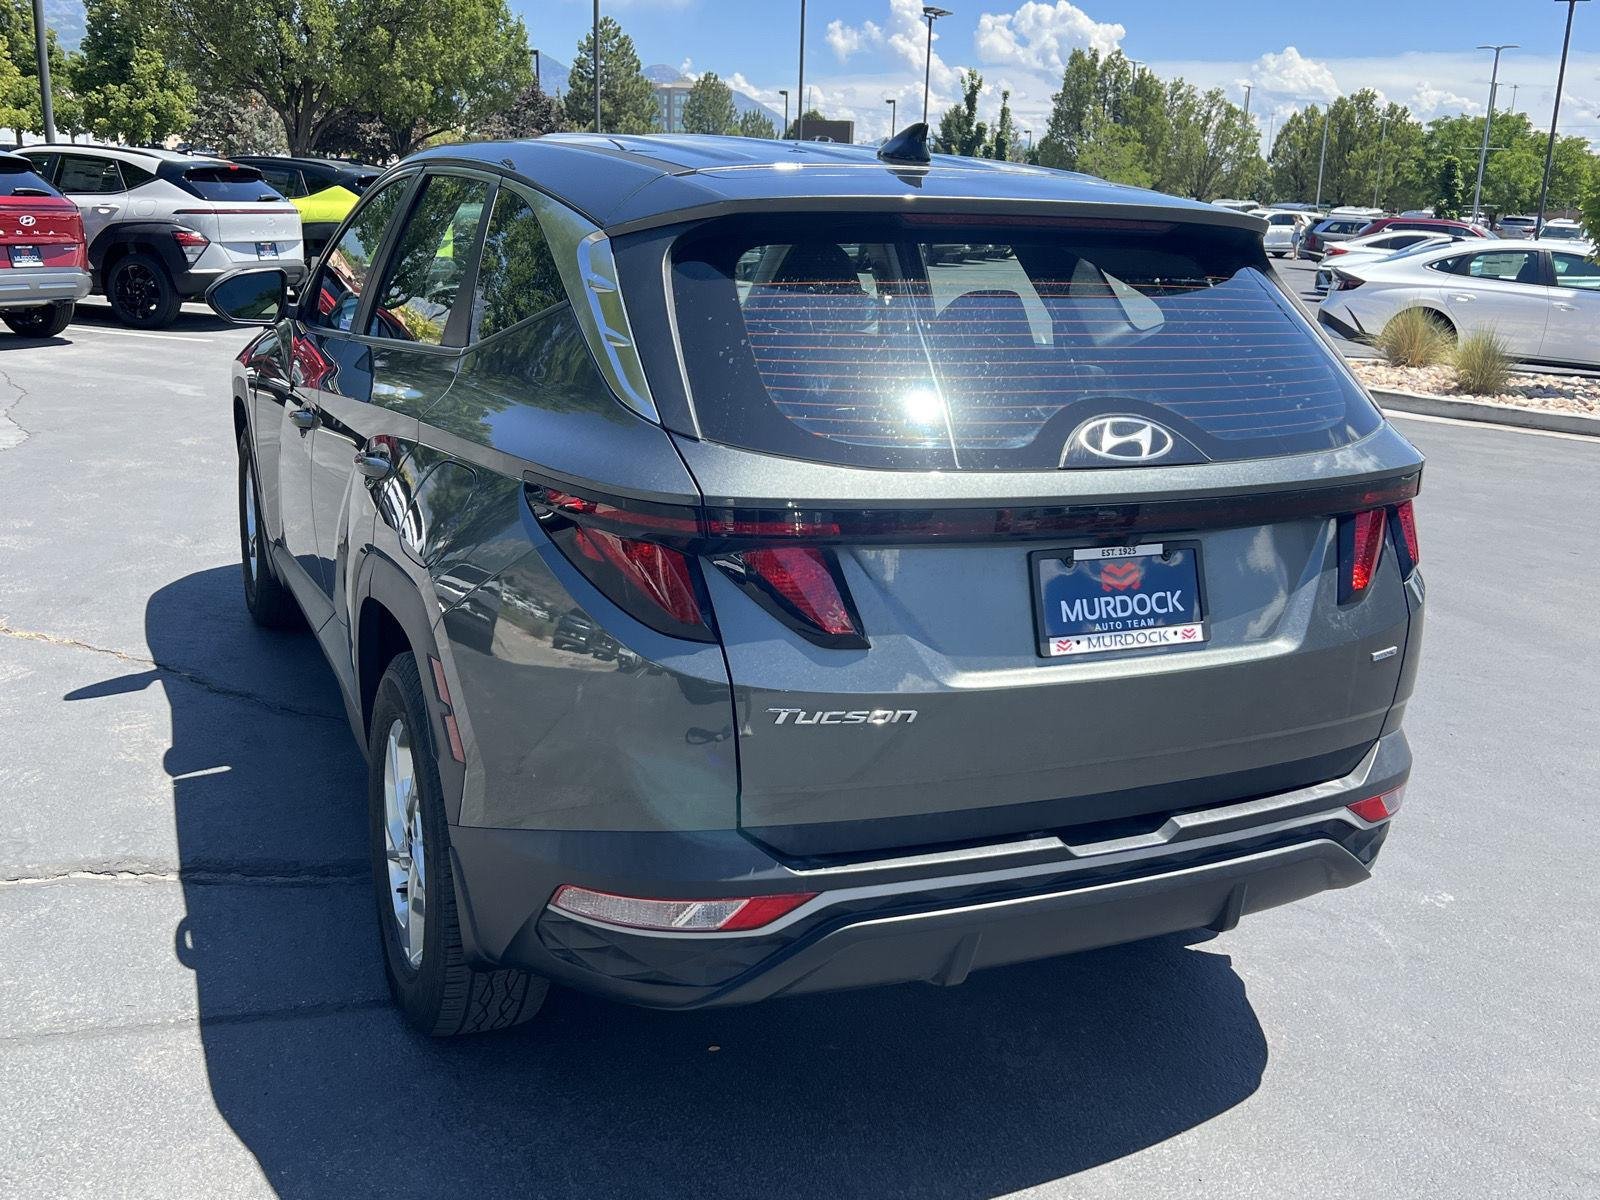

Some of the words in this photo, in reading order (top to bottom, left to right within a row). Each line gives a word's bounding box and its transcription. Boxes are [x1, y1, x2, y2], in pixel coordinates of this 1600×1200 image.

[1101, 549, 1117, 557] EST.
[1118, 547, 1137, 556] 1925
[1060, 590, 1184, 622] MURDOCK
[1094, 621, 1122, 632] AUTO
[1126, 618, 1155, 629] TEAM
[1087, 630, 1170, 649] MURDOCK
